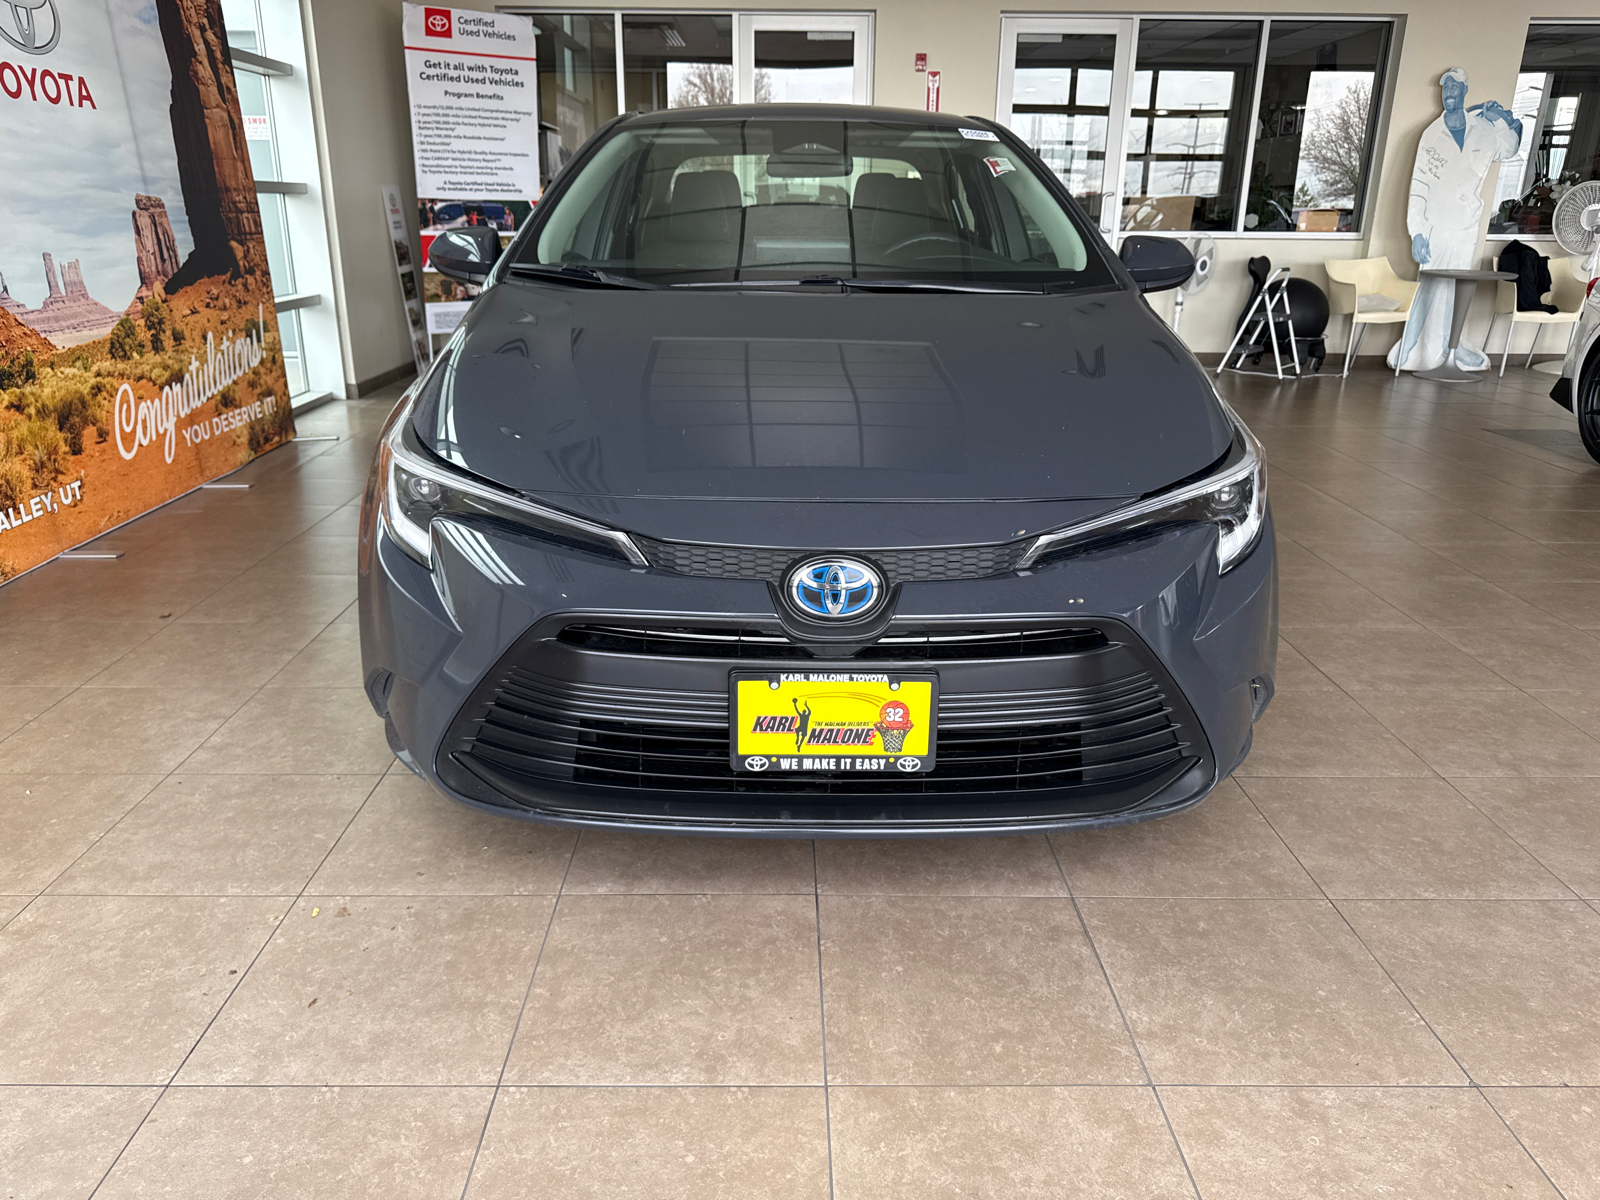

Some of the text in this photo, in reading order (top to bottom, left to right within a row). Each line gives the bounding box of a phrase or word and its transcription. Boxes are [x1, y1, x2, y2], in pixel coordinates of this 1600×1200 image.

[458, 16, 494, 28] Certified
[458, 28, 516, 41] Used Vehicles
[424, 60, 519, 76] Get it all with Toyota
[420, 72, 524, 88] Certified Used Vehicles
[444, 90, 504, 100] Program Benefits
[114, 302, 266, 464] Congratulations!
[182, 396, 277, 447] YOU DESERVE IT!
[59, 480, 81, 505] UT
[780, 674, 889, 683] KARL MALONE TOYOTA
[885, 707, 904, 722] 32
[752, 716, 798, 734] KARL
[806, 728, 875, 746] MALONE
[780, 758, 886, 770] WE MAKE IT EASY
